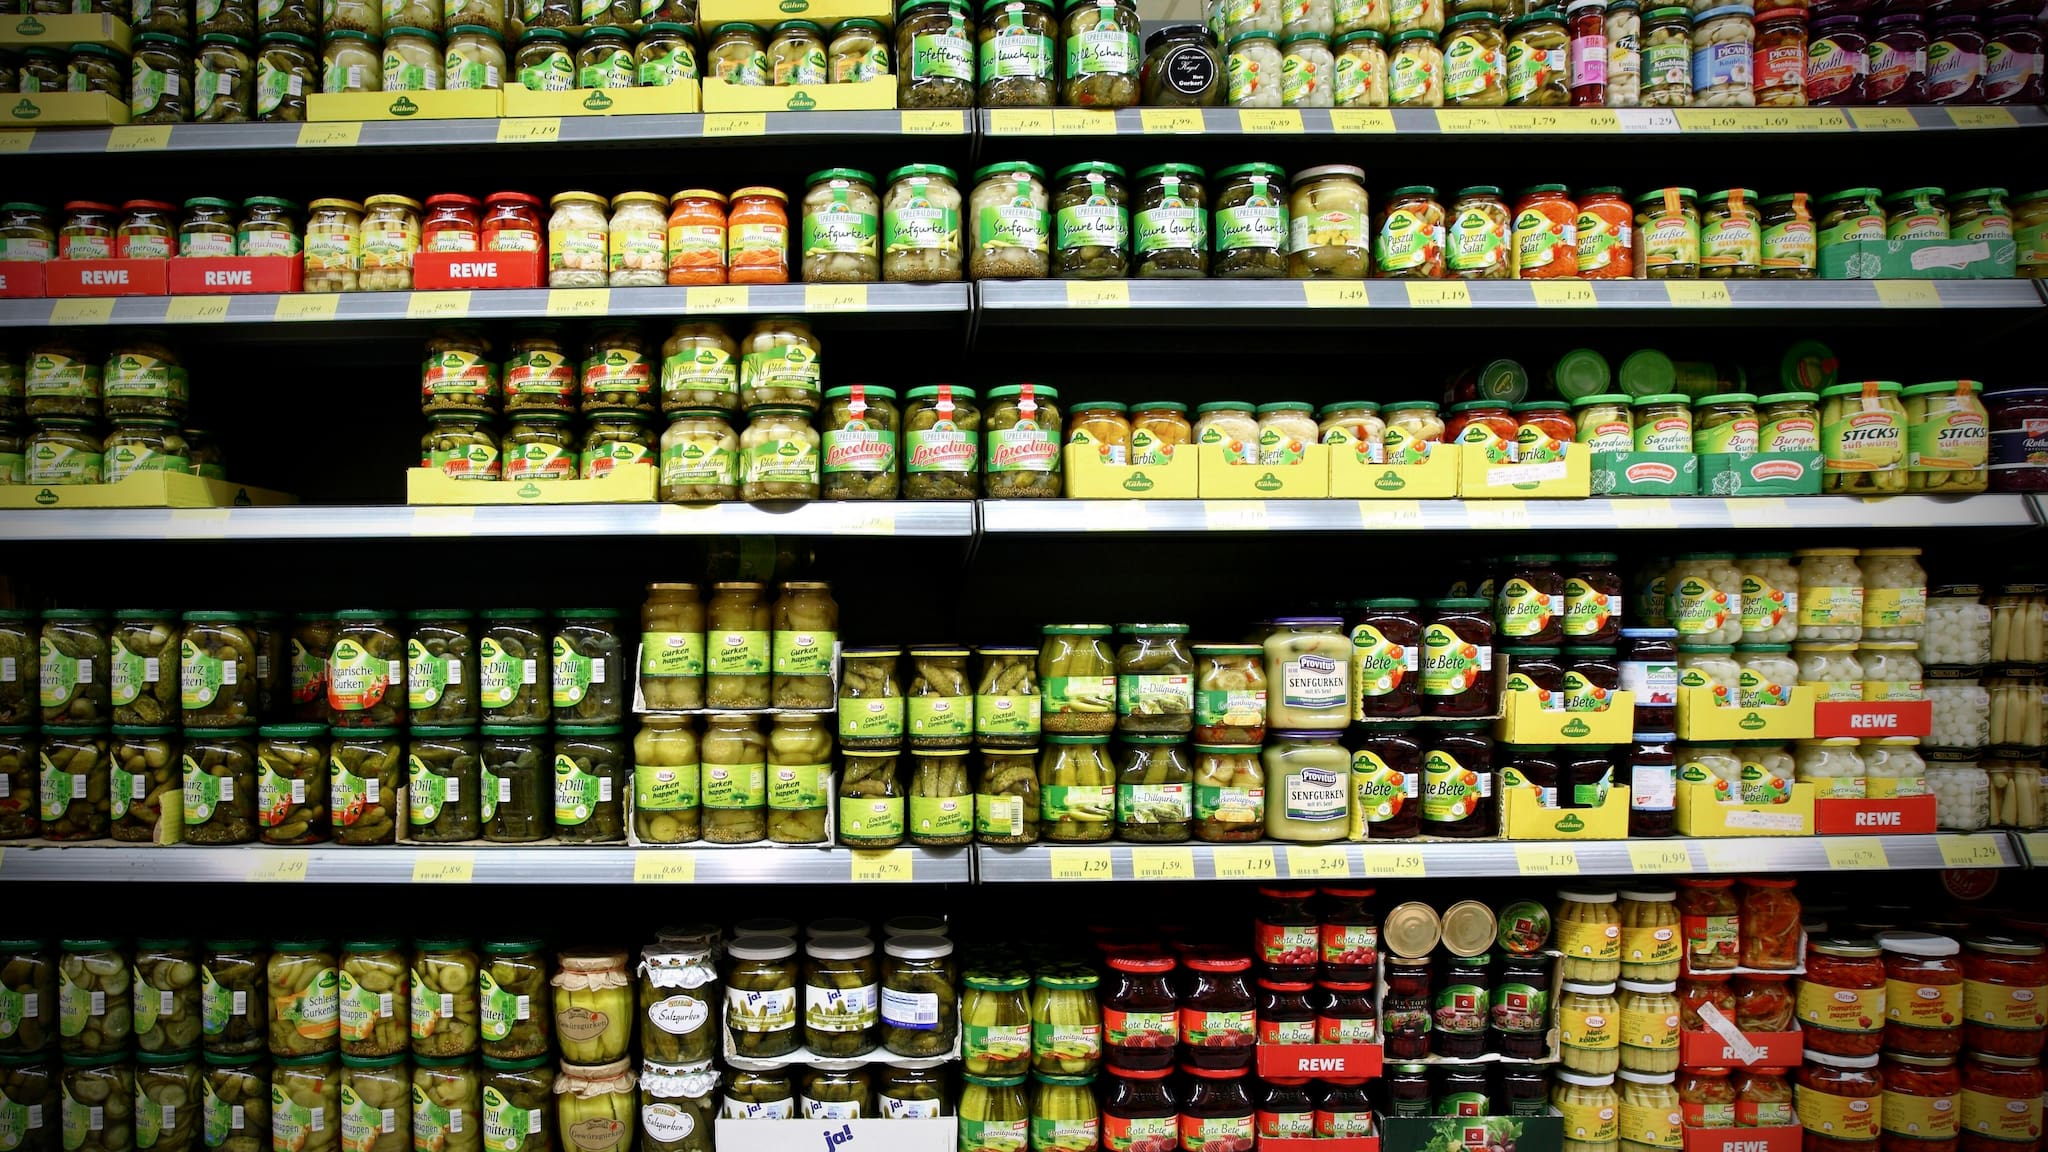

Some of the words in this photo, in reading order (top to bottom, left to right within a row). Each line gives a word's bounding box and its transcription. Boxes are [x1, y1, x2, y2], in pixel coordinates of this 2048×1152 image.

[1532, 117, 1556, 126] 1.79
[1590, 117, 1616, 126] 0.99
[1648, 117, 1672, 126] 1.29
[1712, 117, 1736, 126] 1.69
[1765, 117, 1788, 126] 1.69
[1818, 117, 1842, 126] 1.69
[450, 263, 498, 278] REWE
[81, 270, 129, 285] REWE
[205, 271, 252, 285] REWE
[1339, 290, 1363, 300] 1.49
[1440, 290, 1465, 300] 1.19
[1567, 290, 1590, 300] 1.19
[1701, 290, 1725, 300] 1.49
[1124, 480, 1153, 489] Kühne
[1254, 479, 1283, 488] Kühne
[1375, 479, 1404, 488] Kühne
[1517, 602, 1540, 616] Bete
[1574, 603, 1597, 616] Bete
[661, 648, 689, 658] Gurken
[720, 646, 748, 657] Gurken
[790, 646, 818, 658] Gurken
[415, 662, 433, 675] Dill
[489, 662, 509, 675] Dill
[559, 661, 577, 674] Dill
[1301, 658, 1336, 671] Provitus
[1365, 656, 1391, 670] Bete
[1437, 655, 1464, 670] Bete
[1289, 677, 1344, 688] SENFGURKEN
[1574, 696, 1595, 708] Bete
[1850, 714, 1897, 728] REWE
[1562, 726, 1589, 735] Kühne
[1302, 771, 1337, 784] Provitus
[414, 779, 432, 791] Dill
[565, 779, 584, 792] Dill
[652, 782, 680, 793] Gurken
[708, 780, 733, 791] Gurken
[775, 781, 800, 792] Gurken
[1365, 781, 1391, 796] Bete
[1438, 781, 1465, 796] Bete
[1291, 789, 1345, 801] SENFGURKEN
[1555, 820, 1583, 829] Kühne
[1855, 812, 1901, 826] REWE
[1661, 853, 1686, 863] 0.99
[1972, 847, 1996, 858] 1.29
[1247, 859, 1271, 870] 1.19
[1320, 859, 1345, 870] 2.49
[1395, 857, 1419, 868] 1.59
[1550, 855, 1573, 865] 1.19
[1083, 861, 1108, 872] 1.29
[1296, 933, 1315, 946] Bete
[1356, 933, 1376, 946] Bete
[747, 991, 762, 1006] ja!
[827, 990, 842, 1004] ja!
[658, 1009, 701, 1024] Salzgurken
[1143, 1018, 1163, 1030] Bete
[1223, 1018, 1243, 1030] Bete
[1291, 1029, 1311, 1042] Bete
[1352, 1026, 1371, 1039] Bete
[1298, 1058, 1345, 1073] REWE
[747, 1102, 762, 1117] ja!
[810, 1100, 823, 1114] ja!
[889, 1099, 903, 1113] ja!
[646, 1114, 684, 1131] Salzgurken
[1291, 1120, 1310, 1132] Bete
[1345, 1120, 1365, 1131] Bete
[1148, 1123, 1167, 1136] Bete
[1221, 1123, 1240, 1136] Bete
[823, 1124, 853, 1152] ja!
